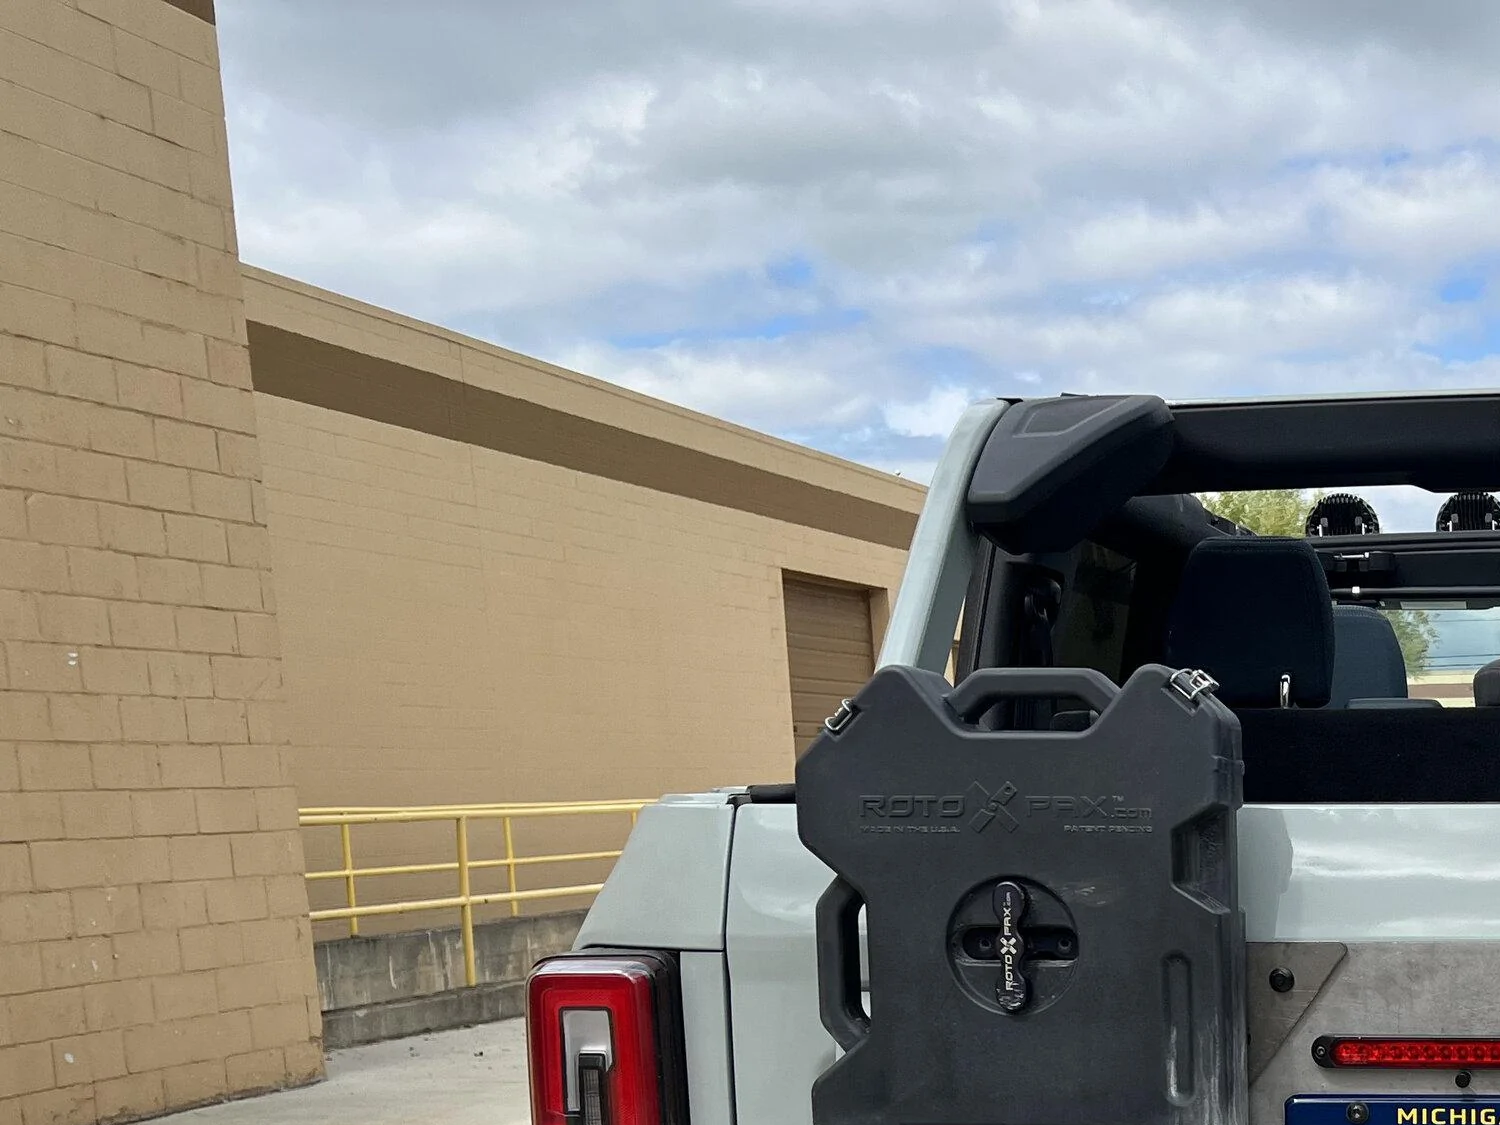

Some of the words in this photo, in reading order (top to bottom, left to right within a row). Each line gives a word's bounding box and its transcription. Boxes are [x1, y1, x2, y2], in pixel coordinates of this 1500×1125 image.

[860, 794, 965, 818] ROTO
[907, 825, 928, 833] THE
[1004, 954, 1014, 991] ROTO
